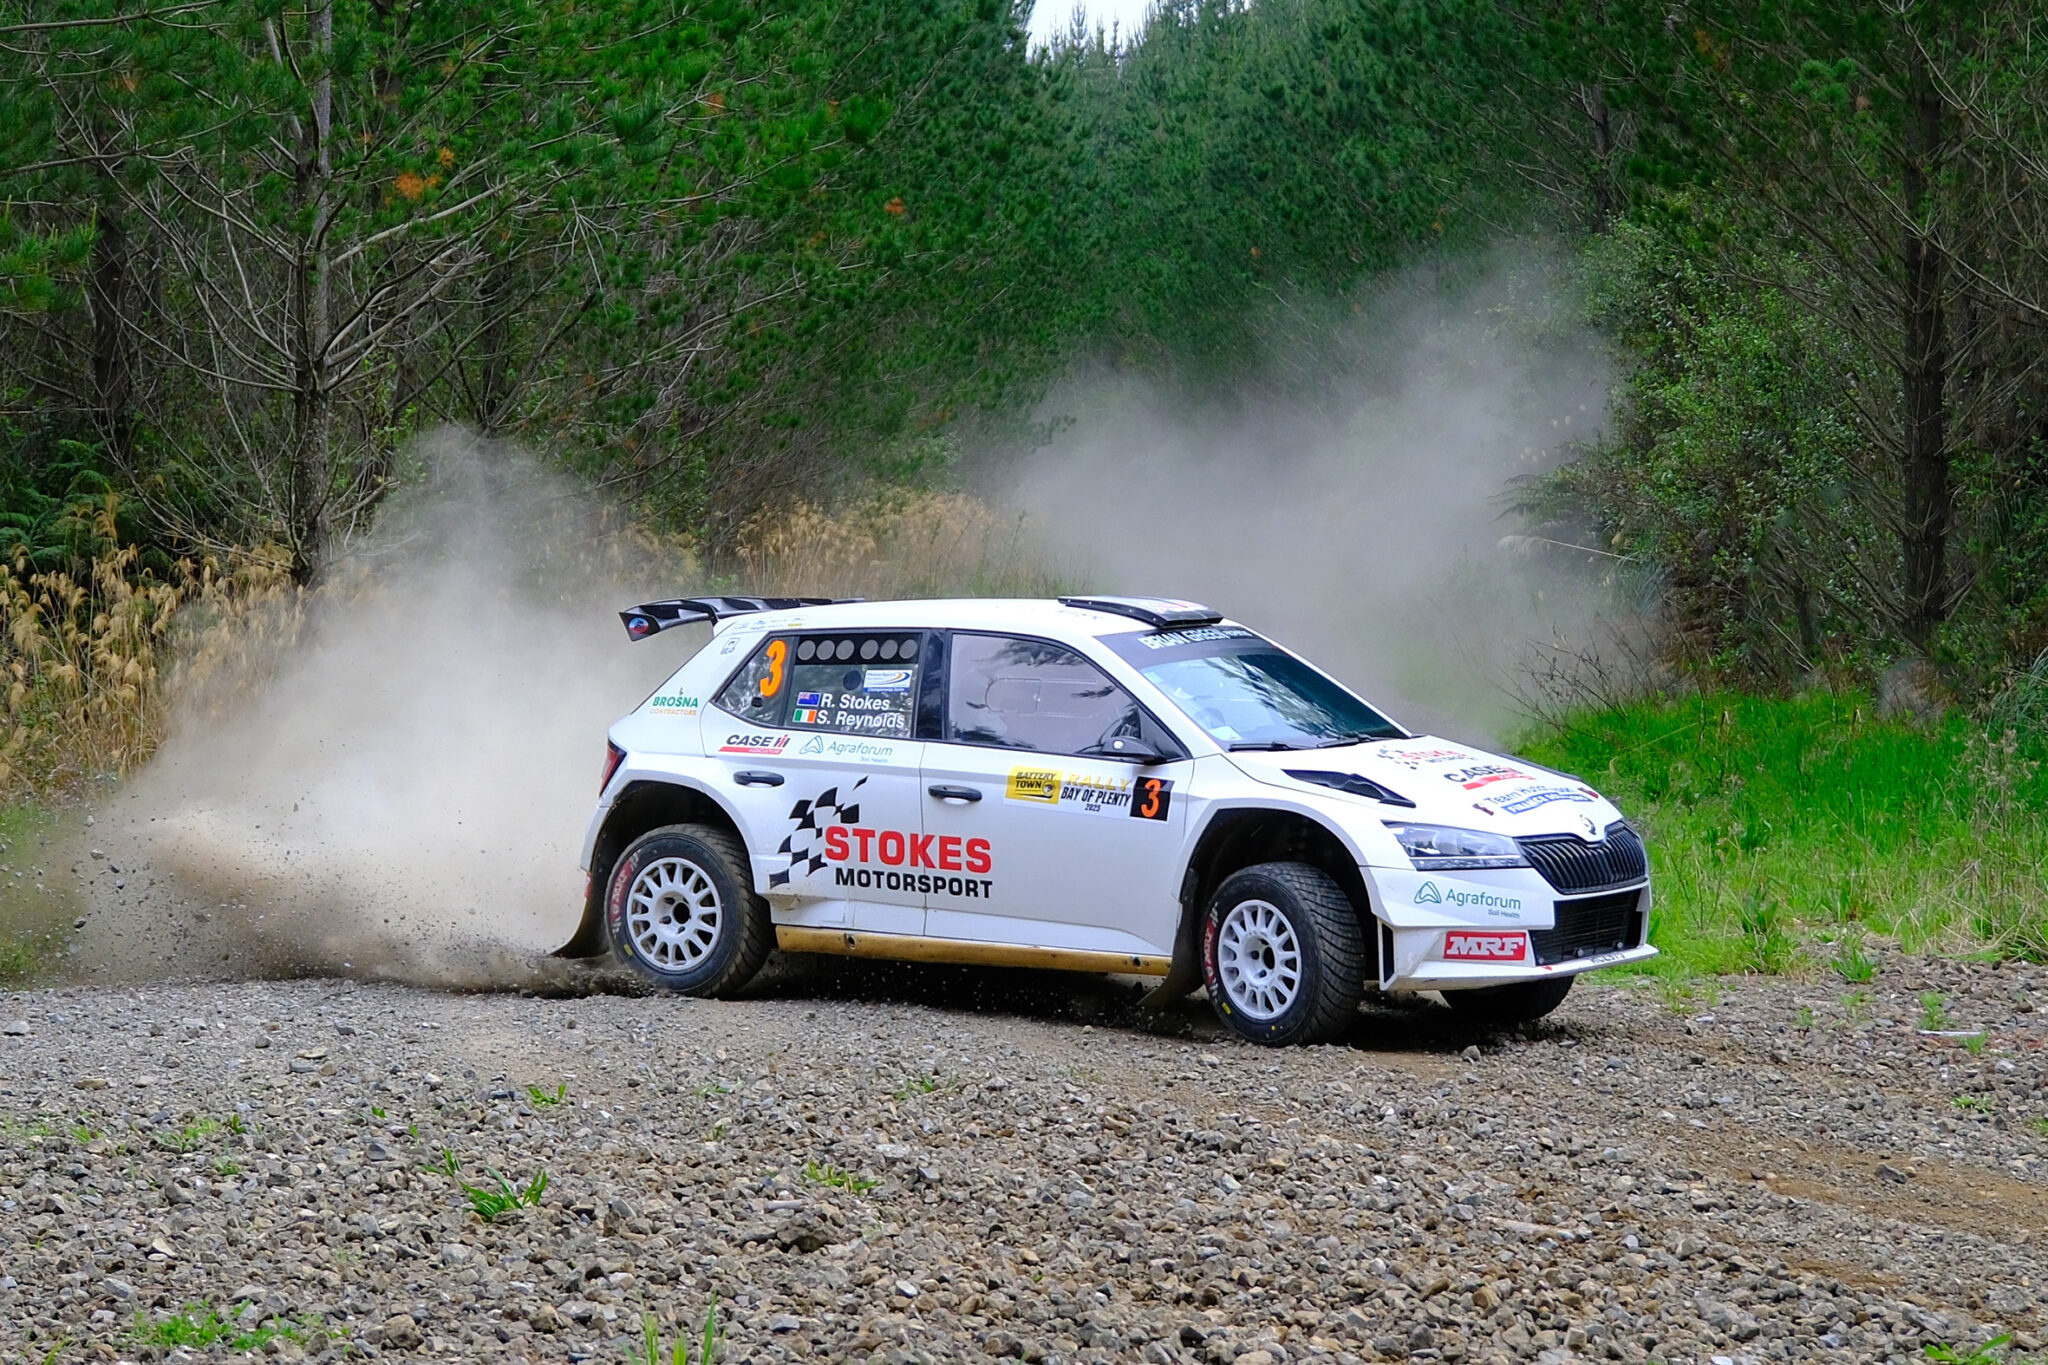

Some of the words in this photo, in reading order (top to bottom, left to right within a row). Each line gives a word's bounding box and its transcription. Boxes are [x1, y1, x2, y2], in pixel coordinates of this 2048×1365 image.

[1137, 632, 1191, 649] BRIAN
[760, 640, 787, 697] 3
[820, 693, 835, 708] R.
[839, 693, 891, 710] Stokes
[816, 709, 831, 725] S.
[835, 710, 906, 730] Reynolds
[726, 734, 774, 747] CASE
[827, 740, 894, 757] Agraforum
[1016, 772, 1057, 780] BATTERY
[1065, 773, 1133, 792] RALLY
[1443, 765, 1503, 783] CASE
[1015, 780, 1043, 789] TOWN
[1060, 786, 1081, 801] BAY
[1081, 788, 1095, 802] OF
[1095, 790, 1132, 808] PLENTY
[1140, 778, 1162, 818] 3
[824, 825, 992, 874] STOKES
[835, 867, 993, 899] MOTORSPORT
[1445, 888, 1522, 910] Agraforum
[1446, 936, 1524, 956] MRF
